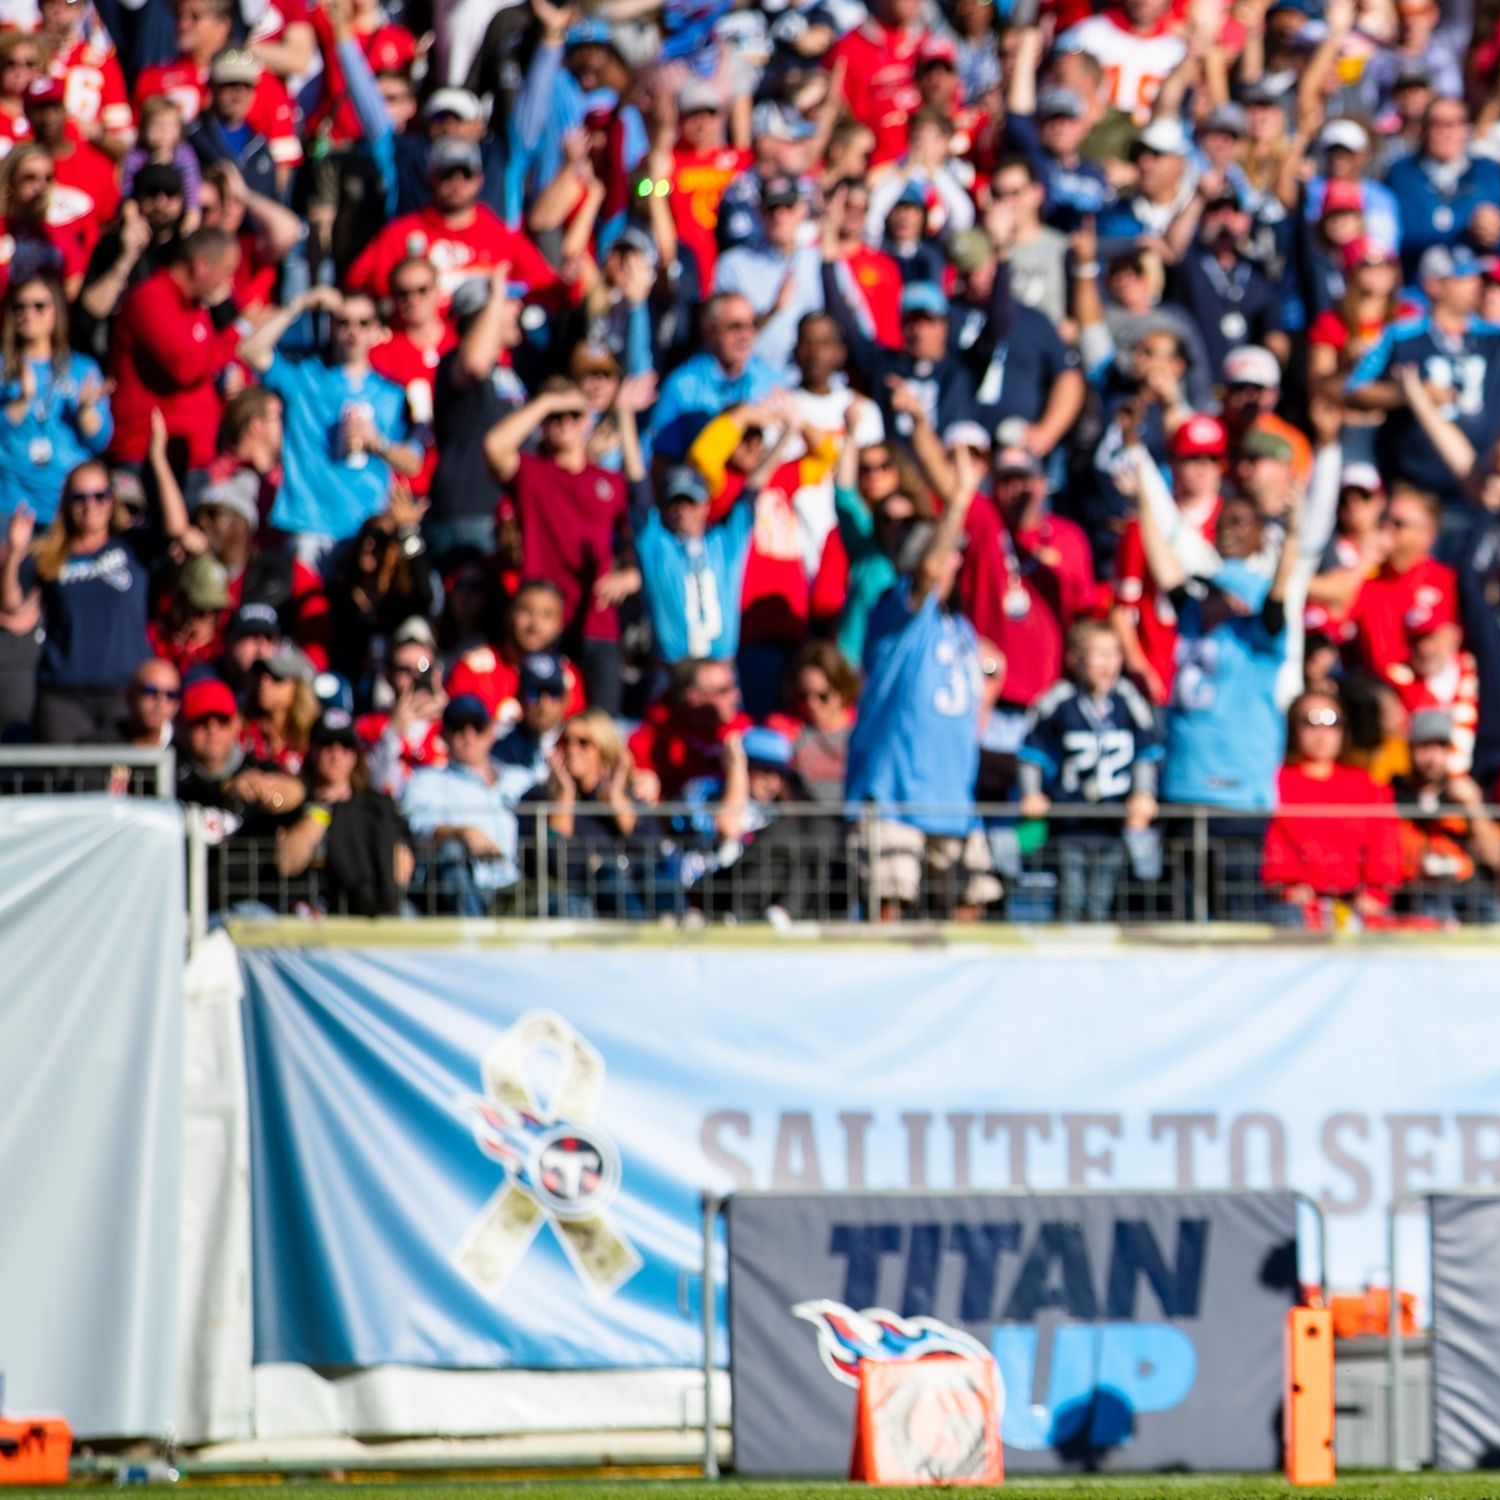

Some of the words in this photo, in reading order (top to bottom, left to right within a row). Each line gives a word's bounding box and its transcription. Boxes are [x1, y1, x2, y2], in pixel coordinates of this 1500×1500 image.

[1060, 729, 1134, 798] 22
[699, 1110, 1122, 1190] SALUTE
[1151, 1111, 1288, 1190] TO
[828, 1220, 1210, 1321] TITAN
[990, 1322, 1197, 1450] UP
